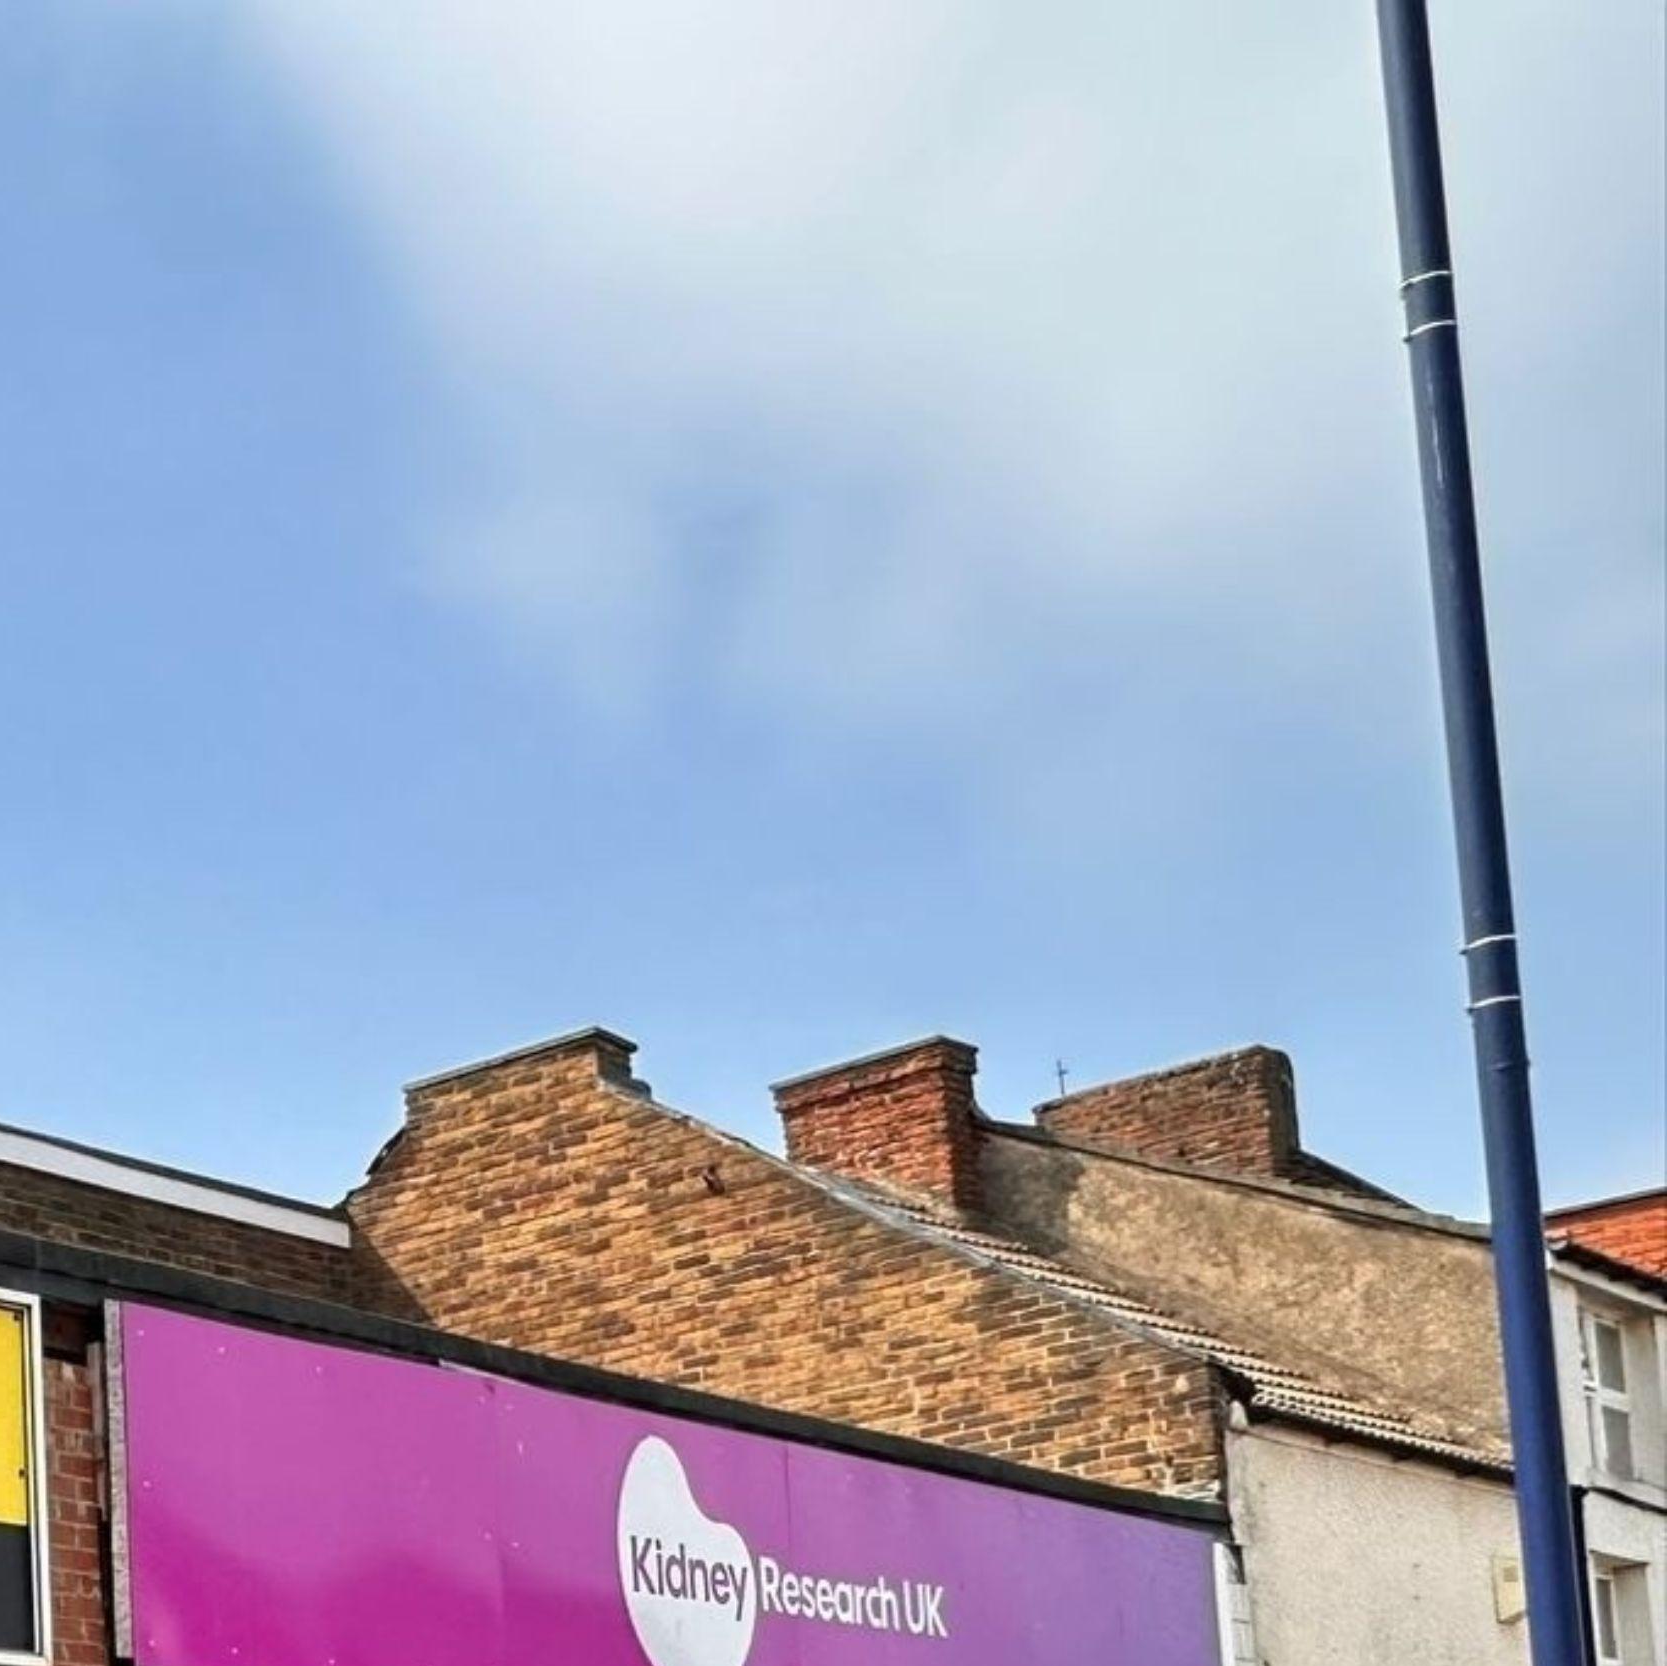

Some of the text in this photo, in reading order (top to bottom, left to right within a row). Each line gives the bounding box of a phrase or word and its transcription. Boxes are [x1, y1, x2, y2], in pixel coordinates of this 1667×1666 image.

[628, 1533, 948, 1639] Kidney Research UK
